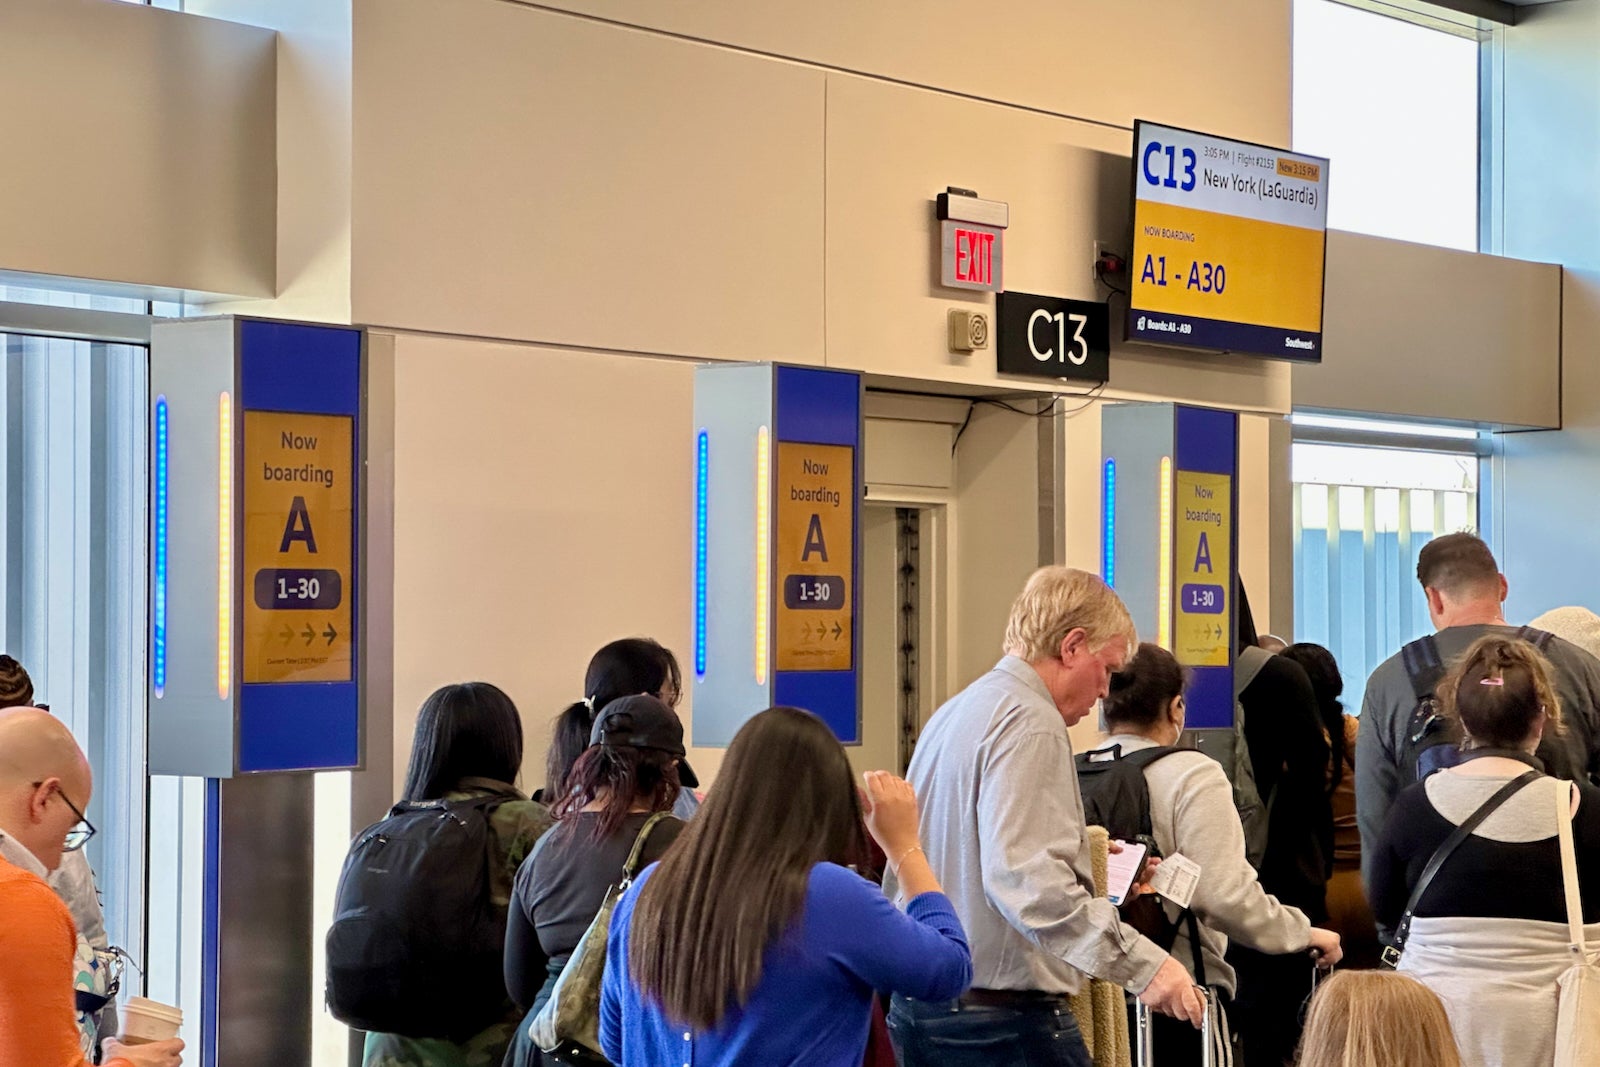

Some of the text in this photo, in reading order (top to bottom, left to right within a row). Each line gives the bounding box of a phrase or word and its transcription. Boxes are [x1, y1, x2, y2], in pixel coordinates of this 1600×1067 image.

[1143, 141, 1197, 192] C13
[1204, 145, 1218, 159] 3:05
[1219, 148, 1230, 161] PM
[1237, 152, 1255, 167] Flight
[1256, 156, 1275, 170] #2153
[1279, 161, 1293, 172] New
[1307, 166, 1318, 177] PM
[1203, 167, 1319, 210] New York (LaGuardia)
[1144, 226, 1195, 242] NOW BOARDING
[955, 228, 995, 285] EXIT
[1141, 254, 1226, 295] A1 - A30
[1027, 308, 1088, 366] C13
[281, 431, 318, 450] Now
[263, 461, 334, 488] boarding
[803, 458, 829, 475] Now
[791, 485, 840, 507] boarding
[1195, 485, 1213, 499] Now
[279, 496, 318, 553] A
[1186, 507, 1221, 526] boarding
[801, 513, 829, 562] A
[1193, 531, 1213, 573] A
[277, 578, 321, 599] 1-30
[800, 582, 831, 601] 1-30
[1192, 590, 1214, 606] 1-30
